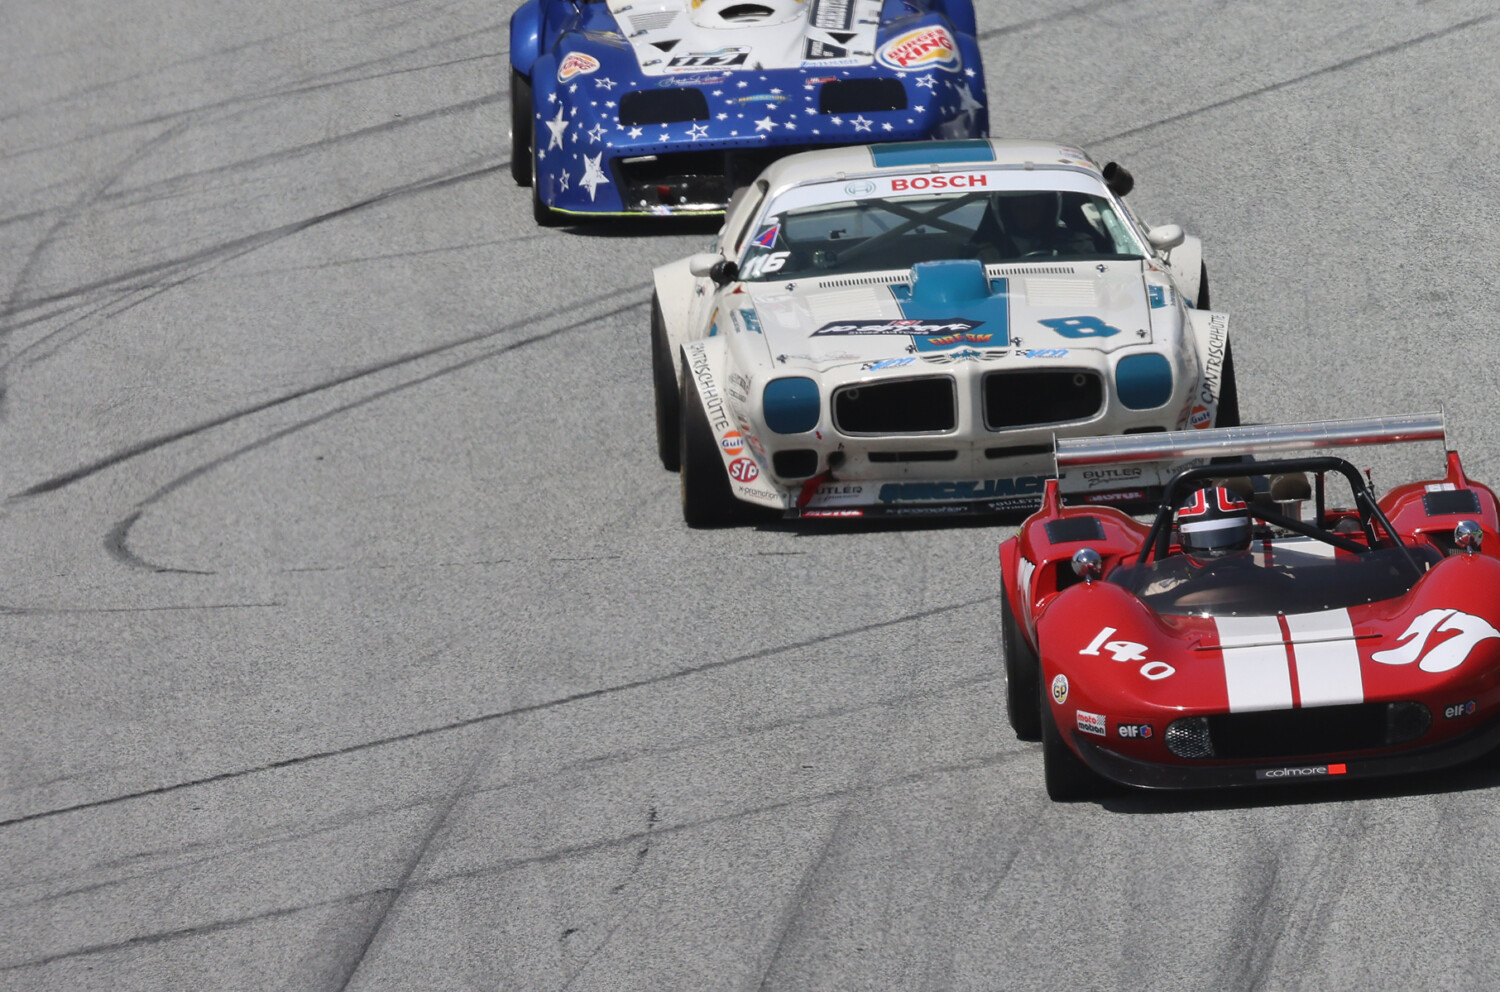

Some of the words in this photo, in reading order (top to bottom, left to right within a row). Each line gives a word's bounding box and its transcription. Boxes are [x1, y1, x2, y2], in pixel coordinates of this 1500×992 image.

[887, 28, 947, 59] BURGER
[897, 35, 953, 67] KING
[891, 174, 988, 192] BOSCH
[741, 251, 791, 281] 116
[1036, 315, 1122, 339] 8
[1190, 412, 1210, 425] Gulf
[730, 461, 759, 480] STP
[1082, 467, 1142, 480] BUTLER
[1088, 491, 1142, 502] MOTUL
[1053, 684, 1067, 699] GP
[1077, 712, 1098, 725] moto
[1444, 704, 1465, 719] elf
[1118, 725, 1139, 738] elf
[1265, 766, 1327, 778] colmore
